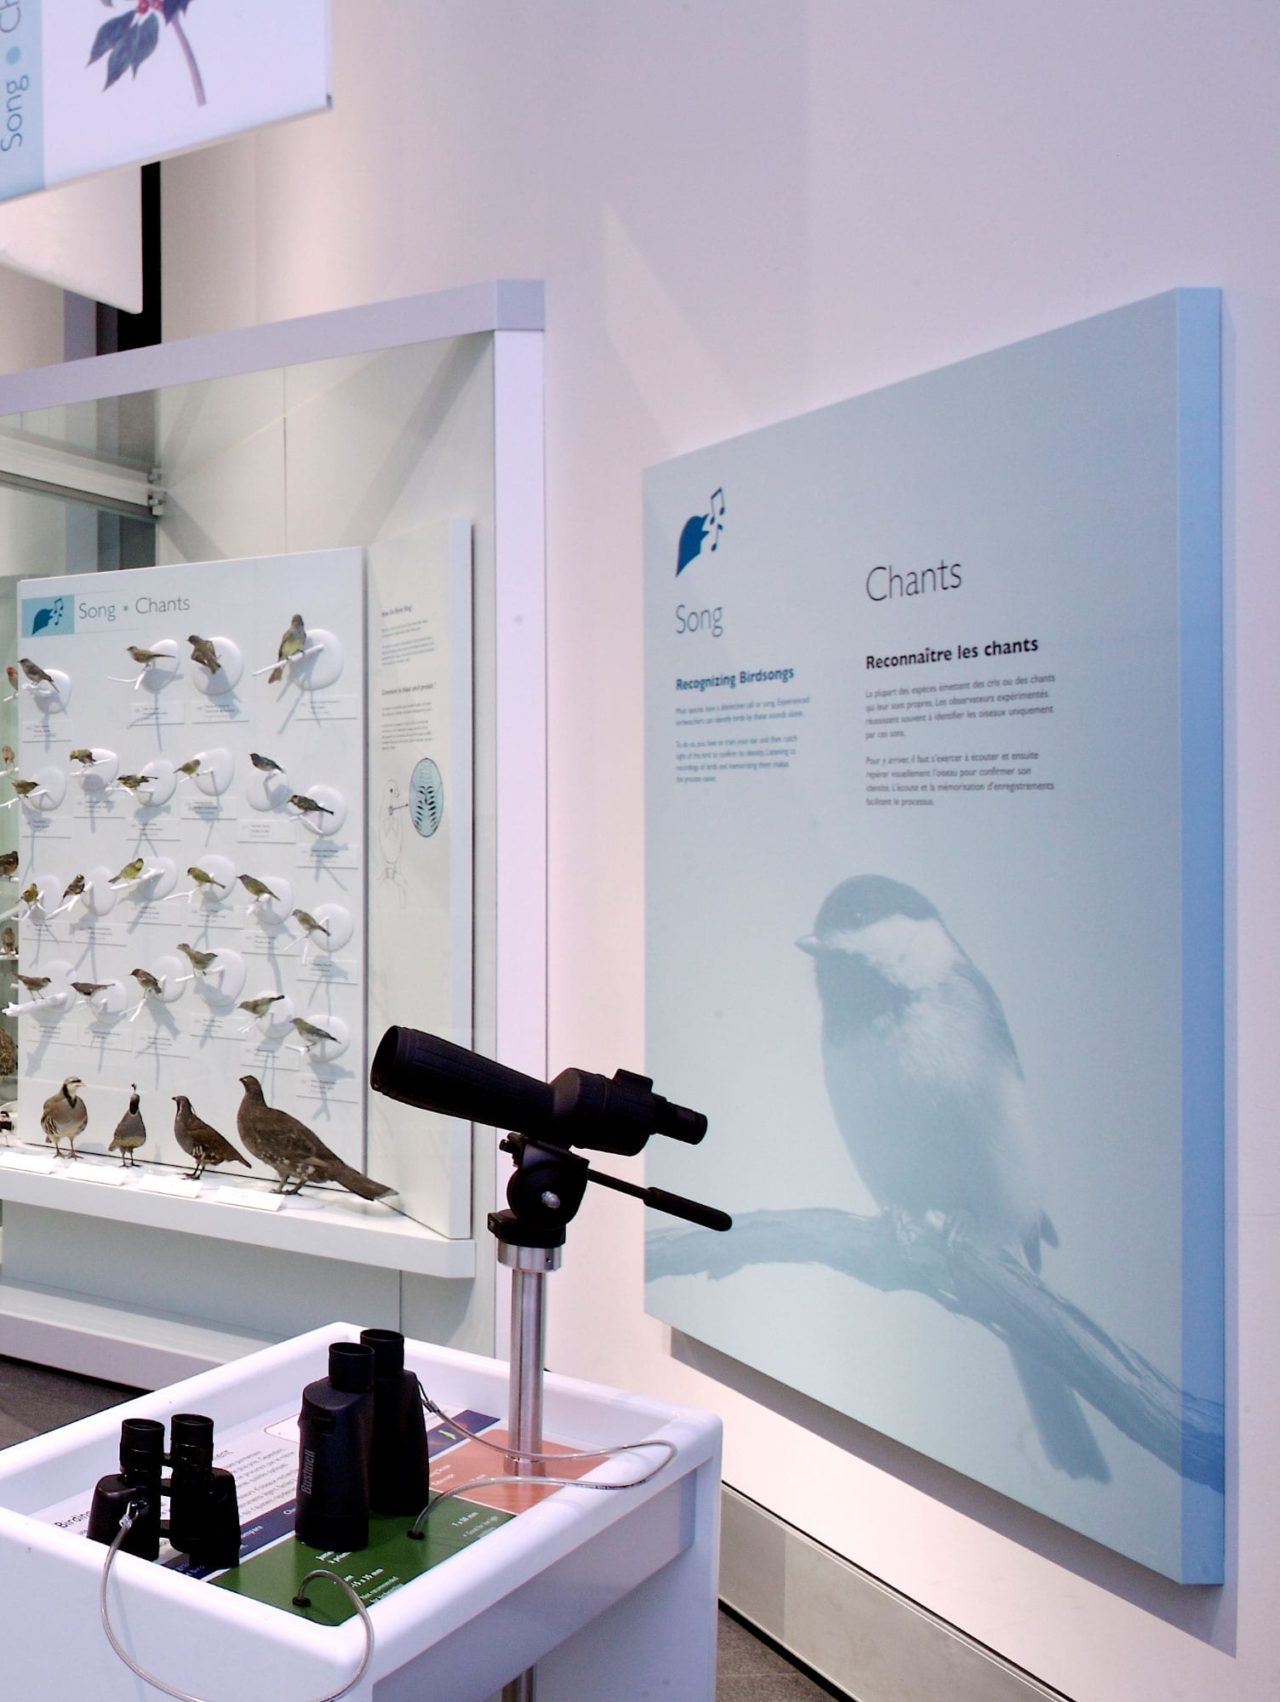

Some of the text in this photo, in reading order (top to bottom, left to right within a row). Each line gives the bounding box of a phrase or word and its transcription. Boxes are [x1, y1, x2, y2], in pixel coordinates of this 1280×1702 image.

[0, 75, 29, 152] Song
[866, 560, 962, 601] Chants
[79, 597, 190, 622] Song Chants
[676, 604, 723, 638] Song
[866, 638, 1039, 670] Reconnaître les chants
[676, 668, 794, 692] Recognizing Birdsongs
[301, 1449, 316, 1495] Bushnell
